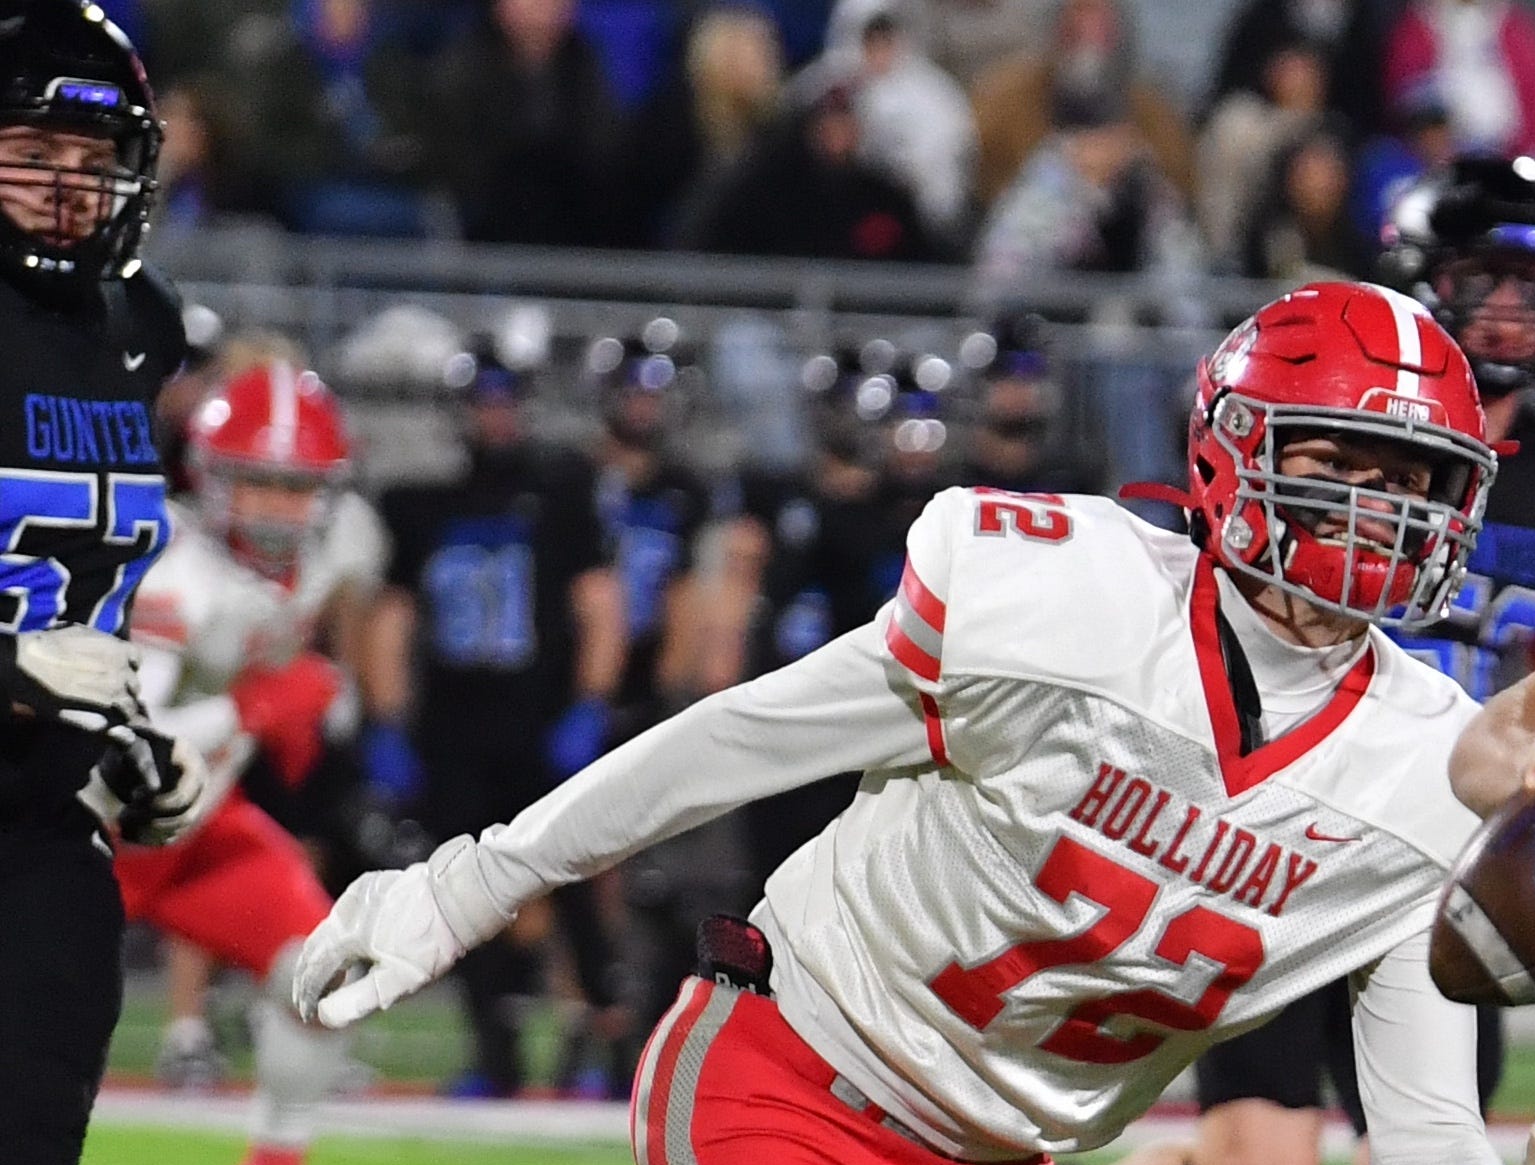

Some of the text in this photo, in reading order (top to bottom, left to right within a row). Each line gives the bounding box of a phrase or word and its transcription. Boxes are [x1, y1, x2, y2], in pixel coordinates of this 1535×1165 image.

[25, 393, 162, 464] GUNTER
[0, 466, 174, 634] 57
[1069, 760, 1318, 918] HOLLIDAY
[927, 827, 1269, 1067] 72
